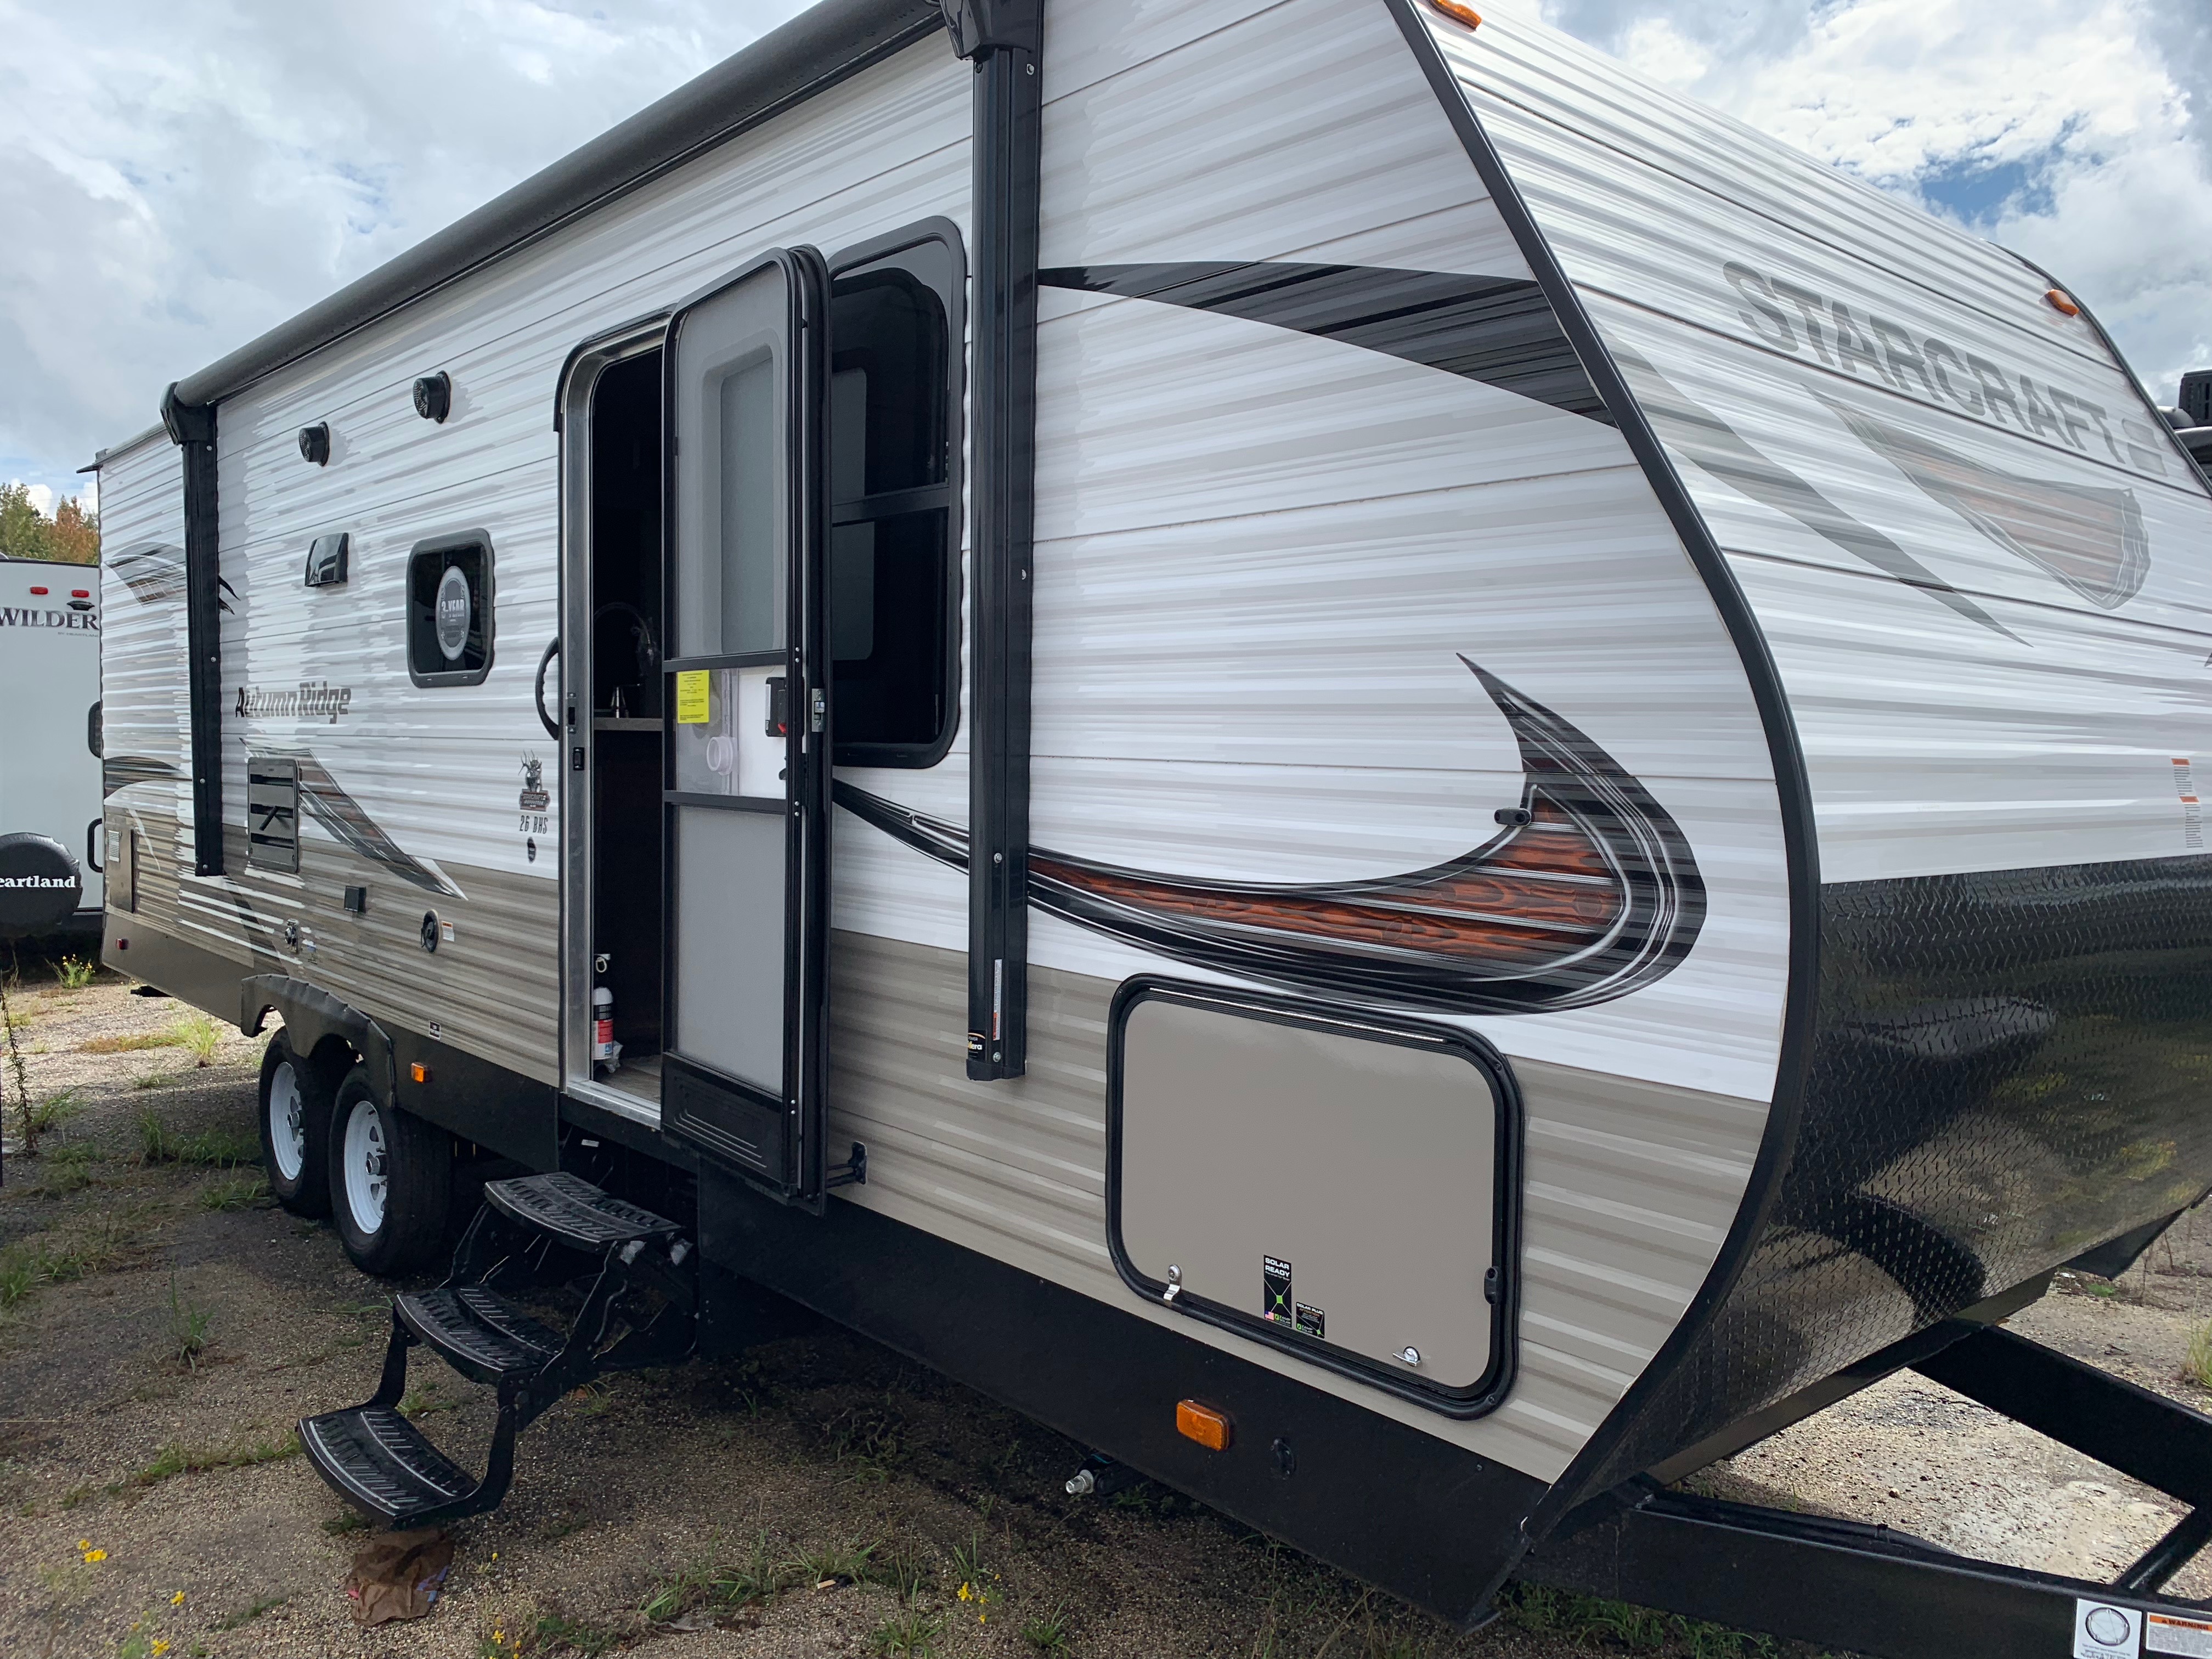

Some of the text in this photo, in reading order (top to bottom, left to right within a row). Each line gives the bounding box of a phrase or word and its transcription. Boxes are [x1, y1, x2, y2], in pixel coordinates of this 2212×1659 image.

[1723, 261, 2126, 464] STARCRAFT
[0, 607, 100, 630] WILDER
[235, 681, 352, 724] Autumn Ridge
[520, 815, 548, 834] 26 BHS
[1265, 1257, 1290, 1270] SOLAR
[1265, 1265, 1290, 1278] READY
[1296, 1302, 1311, 1311] SOLAR
[2169, 1619, 2209, 1630] WARNING
